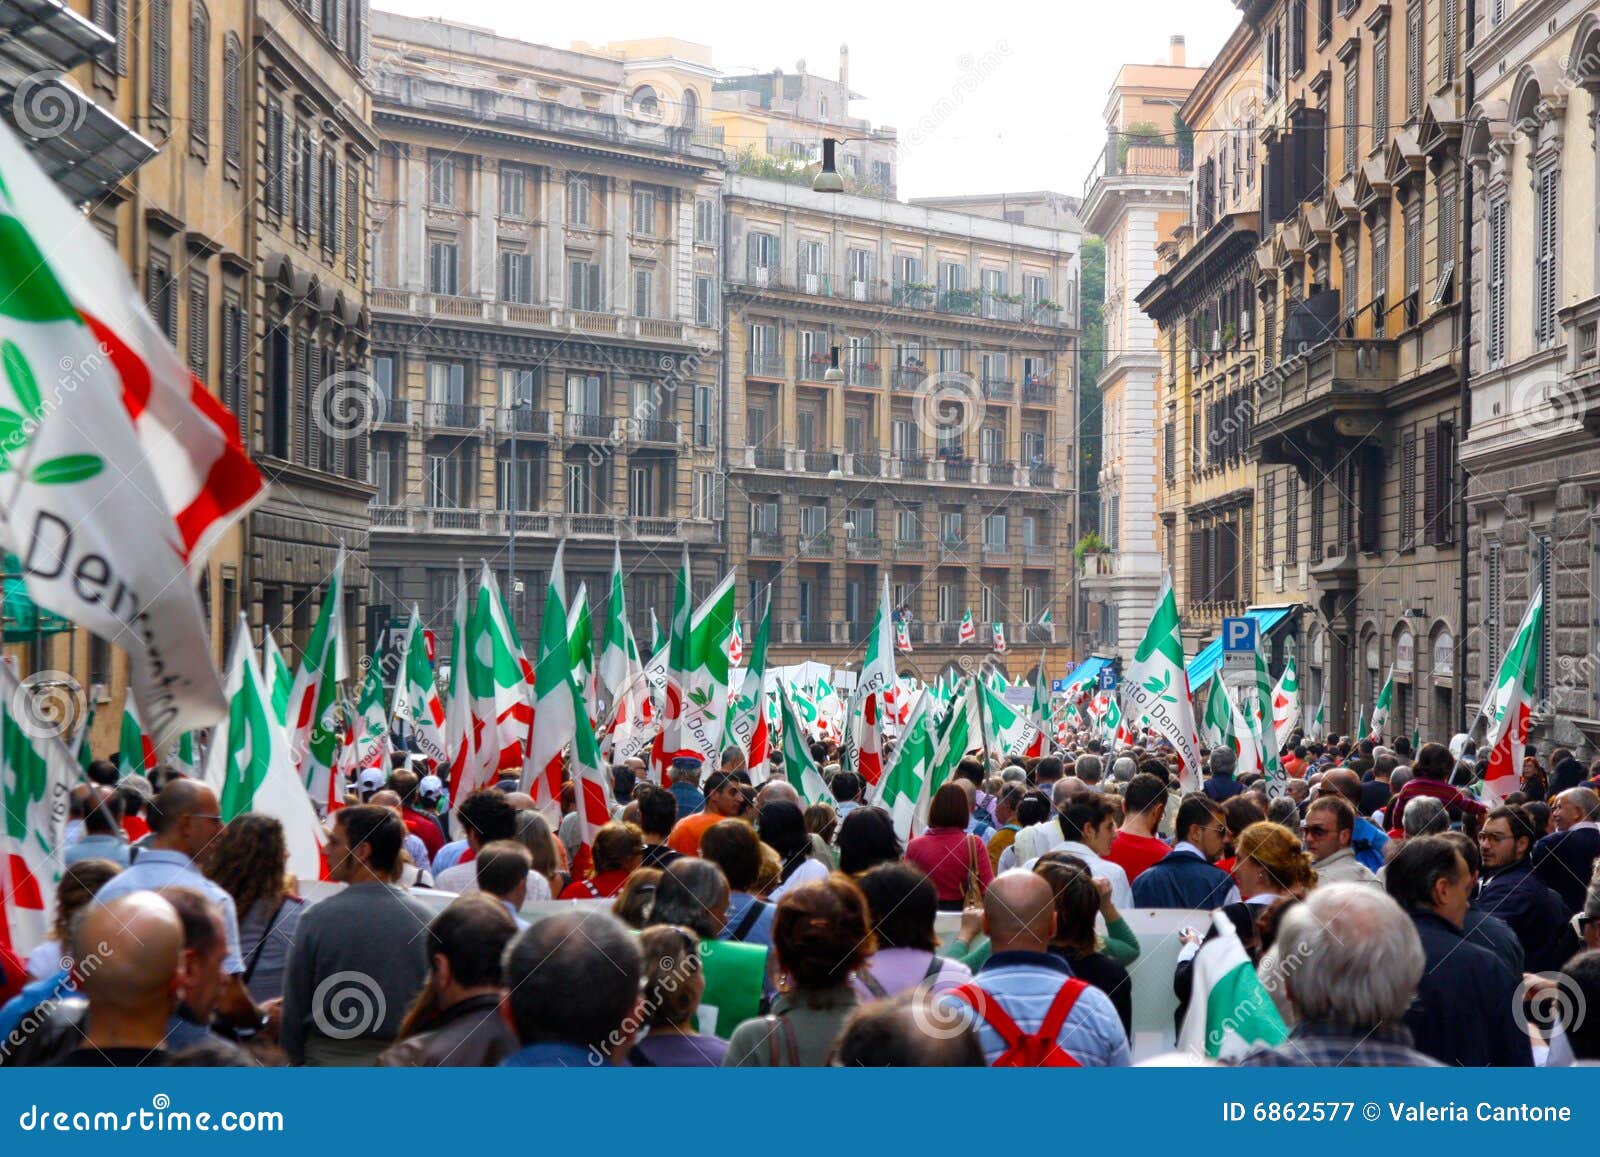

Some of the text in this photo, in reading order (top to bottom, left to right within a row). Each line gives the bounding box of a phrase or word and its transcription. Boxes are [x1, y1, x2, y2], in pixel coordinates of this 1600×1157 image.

[1230, 621, 1250, 648] P
[1053, 681, 1061, 690] P
[1103, 676, 1113, 689] P
